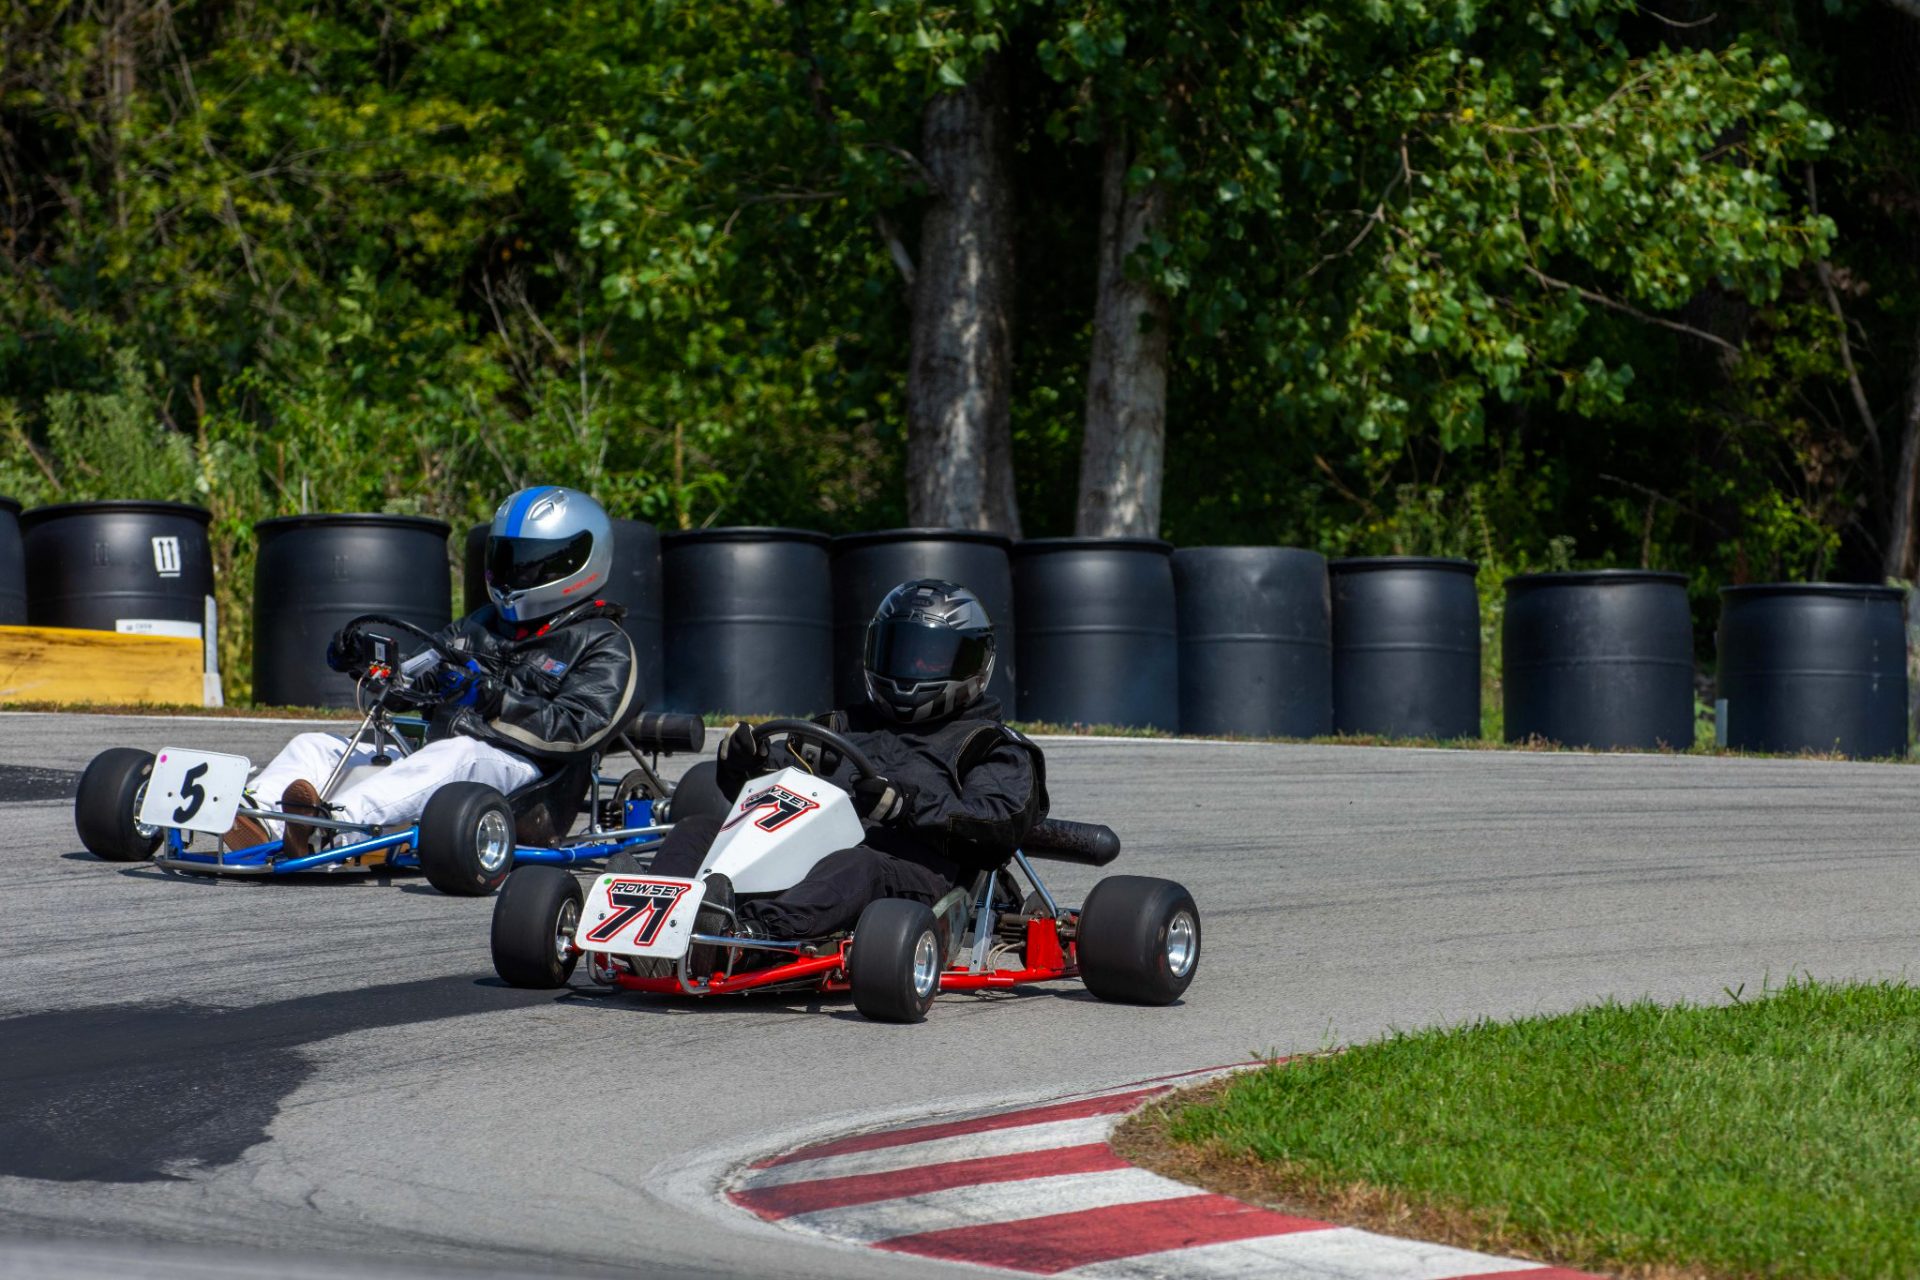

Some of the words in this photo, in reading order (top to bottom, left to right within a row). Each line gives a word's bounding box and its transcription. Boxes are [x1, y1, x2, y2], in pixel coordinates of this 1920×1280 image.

[172, 762, 208, 824] 5
[721, 793, 803, 830] 71
[747, 785, 815, 809] WSEY
[611, 882, 685, 897] ROWSEY
[590, 893, 677, 943] 71
